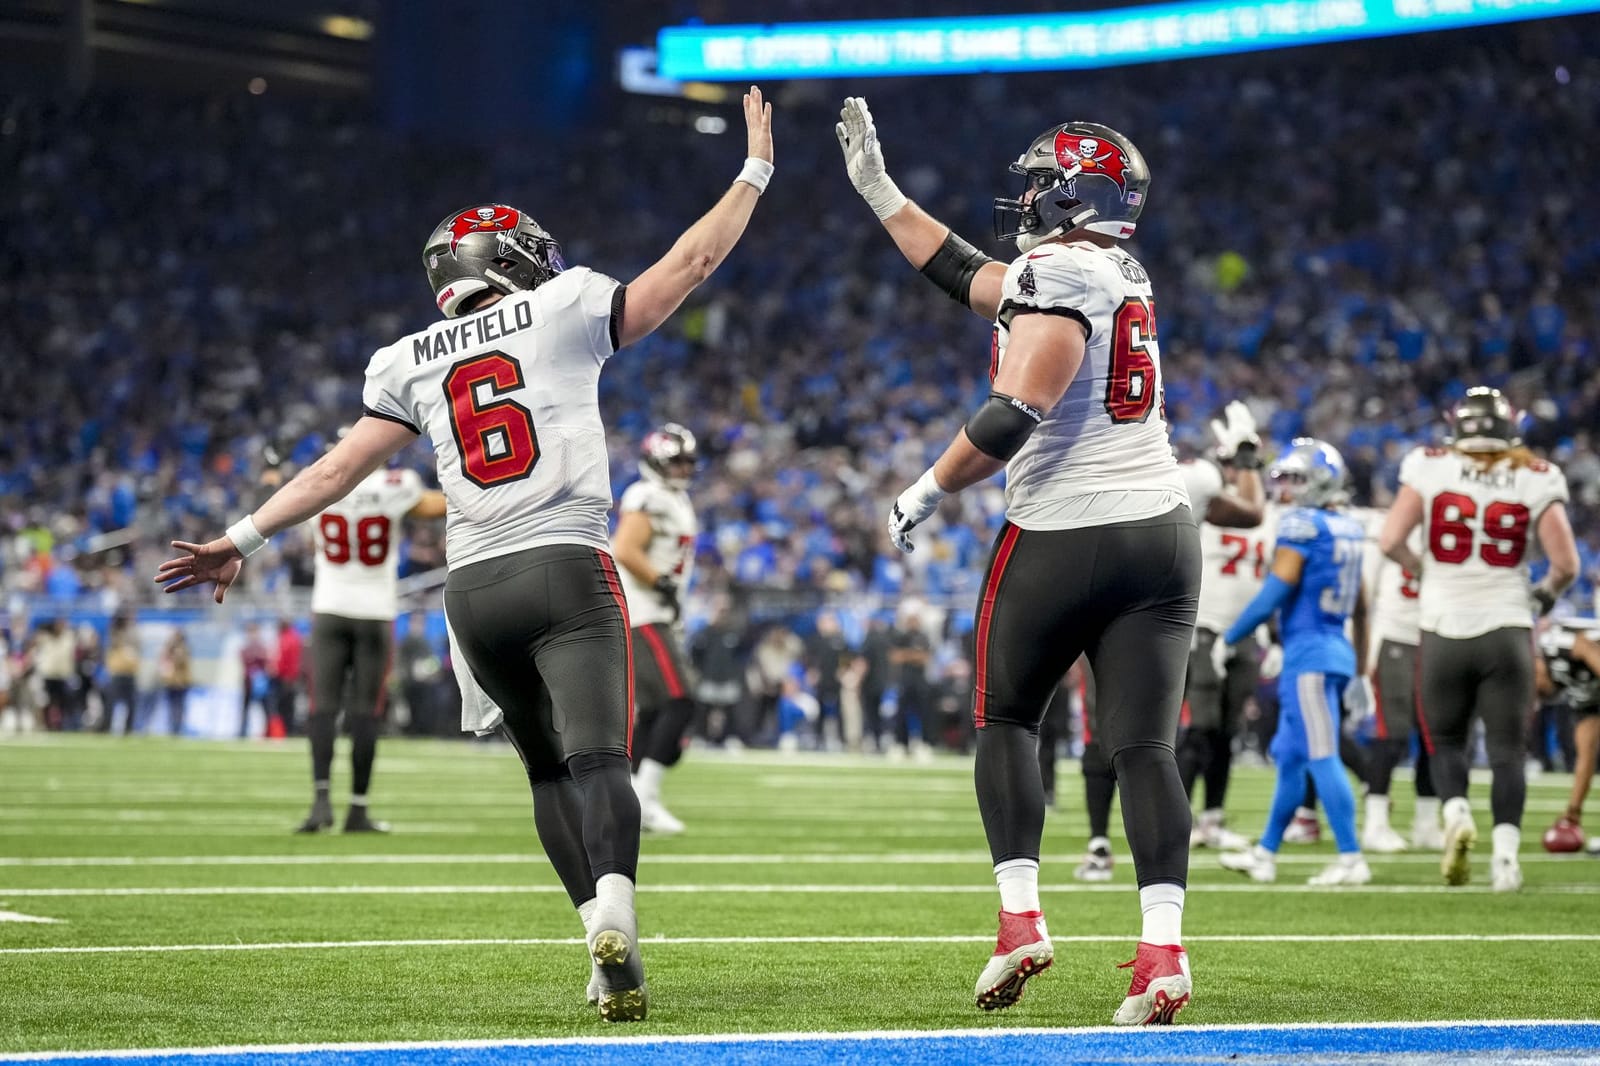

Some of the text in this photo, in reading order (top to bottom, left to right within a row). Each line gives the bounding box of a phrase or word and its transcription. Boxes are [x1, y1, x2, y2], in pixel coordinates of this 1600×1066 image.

[413, 300, 533, 365] MAYFIELD
[1104, 296, 1165, 424] 6
[442, 350, 541, 489] 6
[320, 513, 390, 567] 98
[1429, 491, 1530, 568] 69
